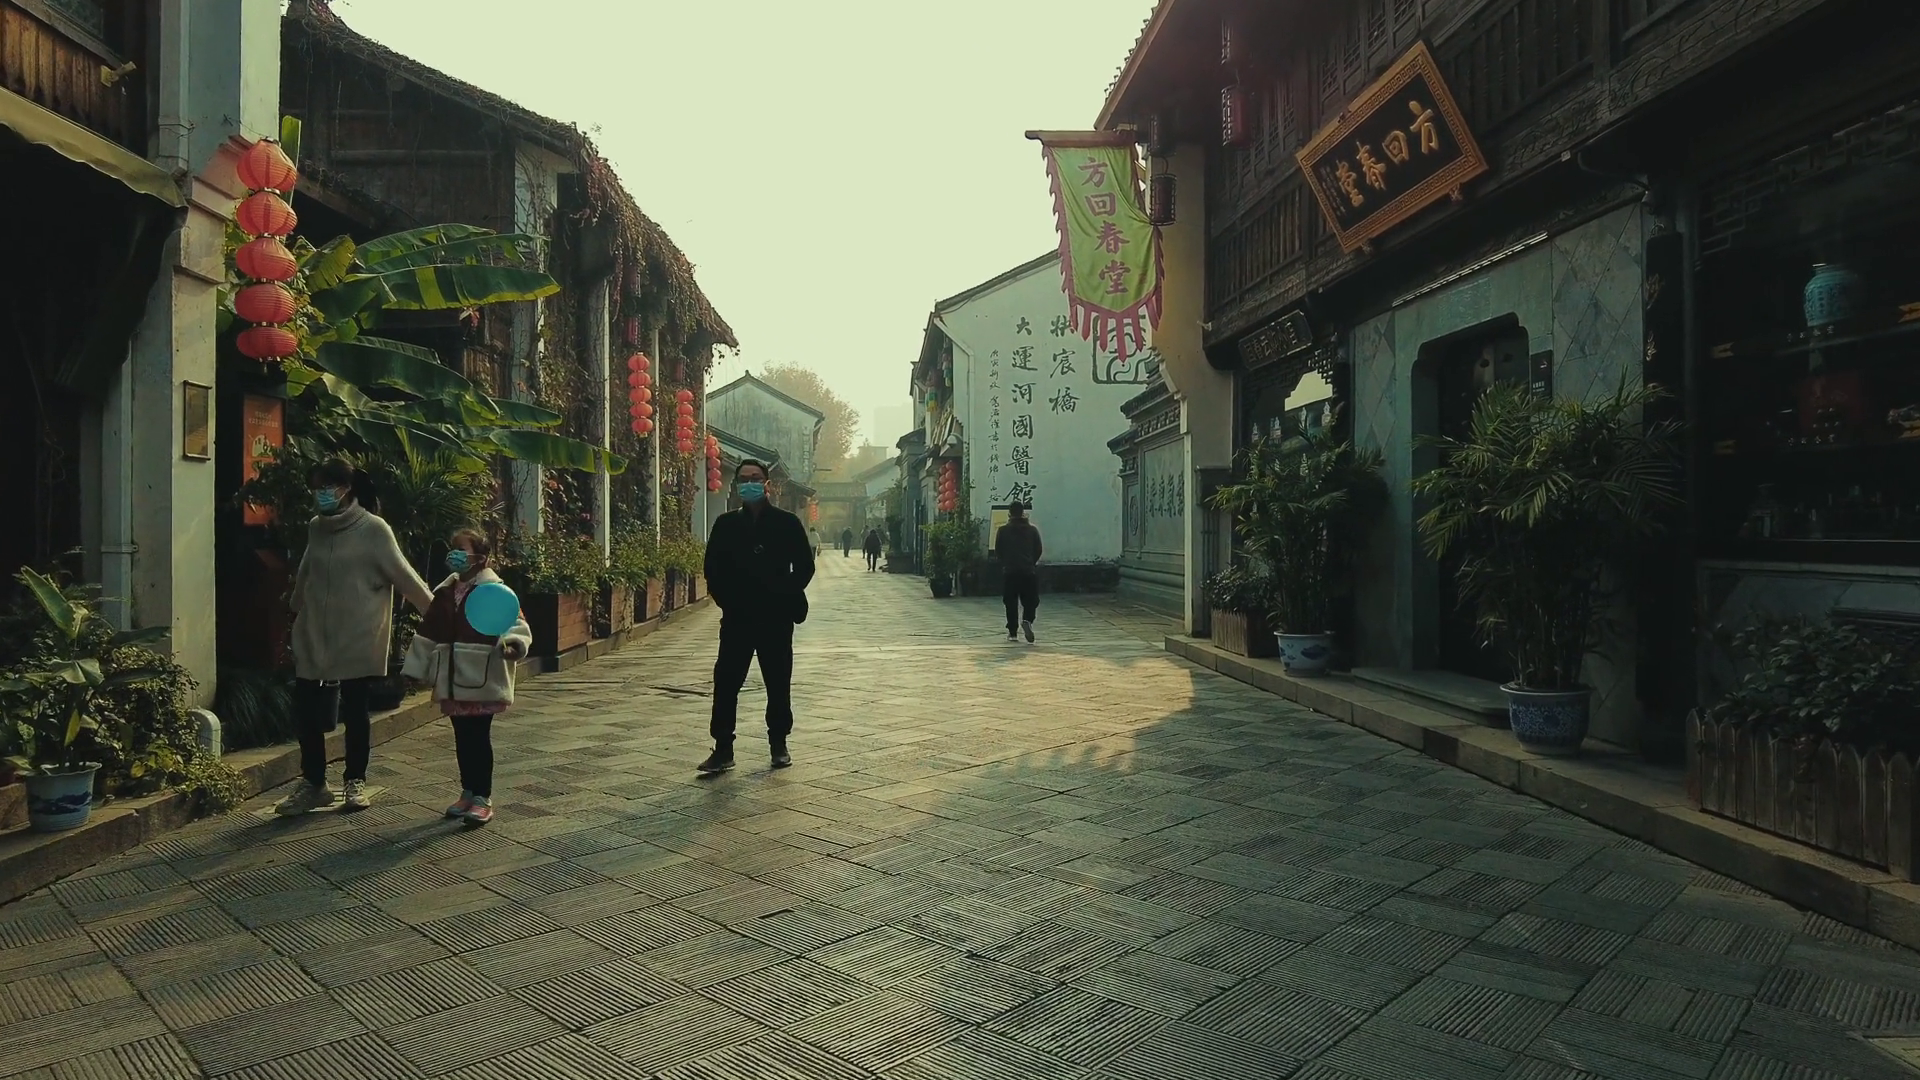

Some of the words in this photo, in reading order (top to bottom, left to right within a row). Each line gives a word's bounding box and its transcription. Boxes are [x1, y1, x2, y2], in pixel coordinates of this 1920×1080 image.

[1335, 100, 1439, 208] 方回春堂
[1077, 156, 1131, 295] 方回春堂
